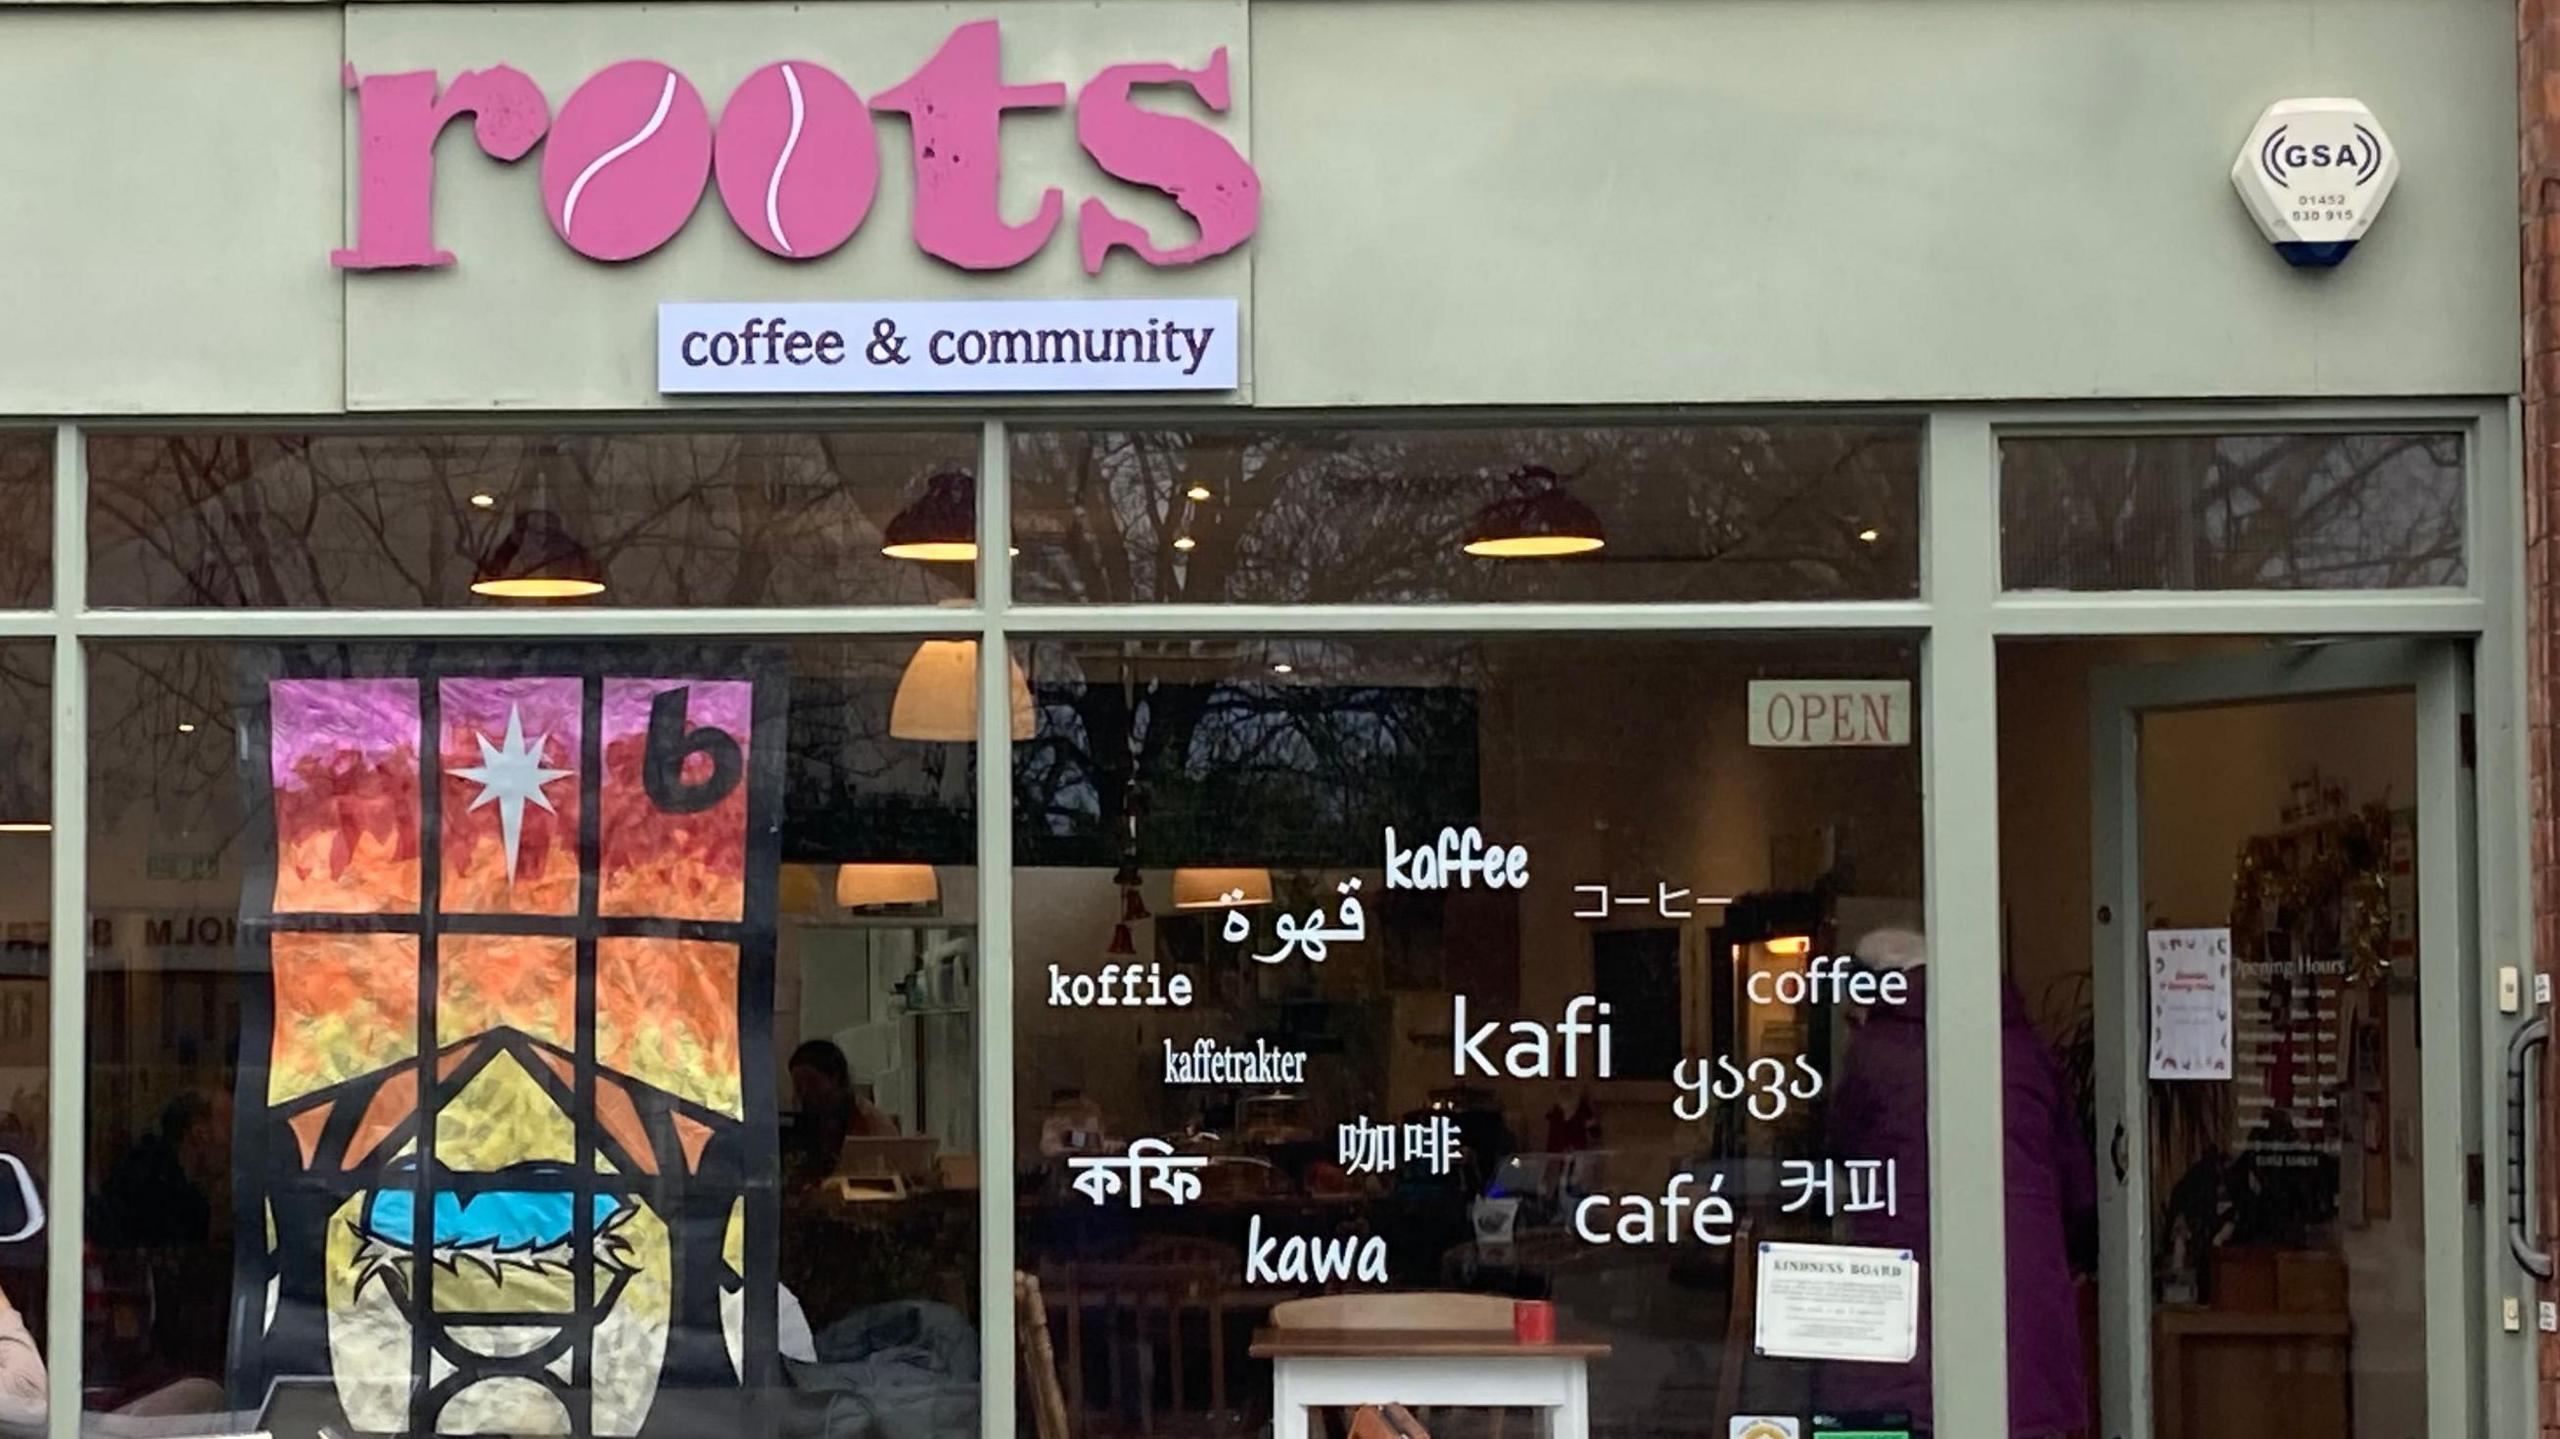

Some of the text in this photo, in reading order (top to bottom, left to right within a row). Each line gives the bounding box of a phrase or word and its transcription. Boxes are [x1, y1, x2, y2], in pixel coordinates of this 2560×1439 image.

[331, 19, 1262, 276] roots
[2284, 144, 2358, 168] GSA
[2298, 194, 2346, 206] 01452
[681, 317, 1215, 376] coffee & community
[1766, 692, 1892, 743] OPEN
[1385, 826, 1529, 890] kaffee
[1221, 877, 1365, 963] قهوة
[1574, 882, 1732, 918] コーヒー
[1048, 962, 1192, 1006] koffie
[1747, 956, 1907, 1004] coffee
[2298, 954, 2346, 975] Hours
[1163, 1038, 1307, 1083] kaffetrakter
[1454, 995, 1610, 1078] kafi
[1673, 1054, 1823, 1120] ყავა
[1068, 1138, 1208, 1208] কফি
[1339, 1115, 1462, 1175] 咖啡
[1575, 1173, 1733, 1245] café
[1780, 1158, 1896, 1217] 커피
[1246, 1214, 1388, 1284] kawa
[1773, 1259, 1903, 1277] KINDNESS BOARD
